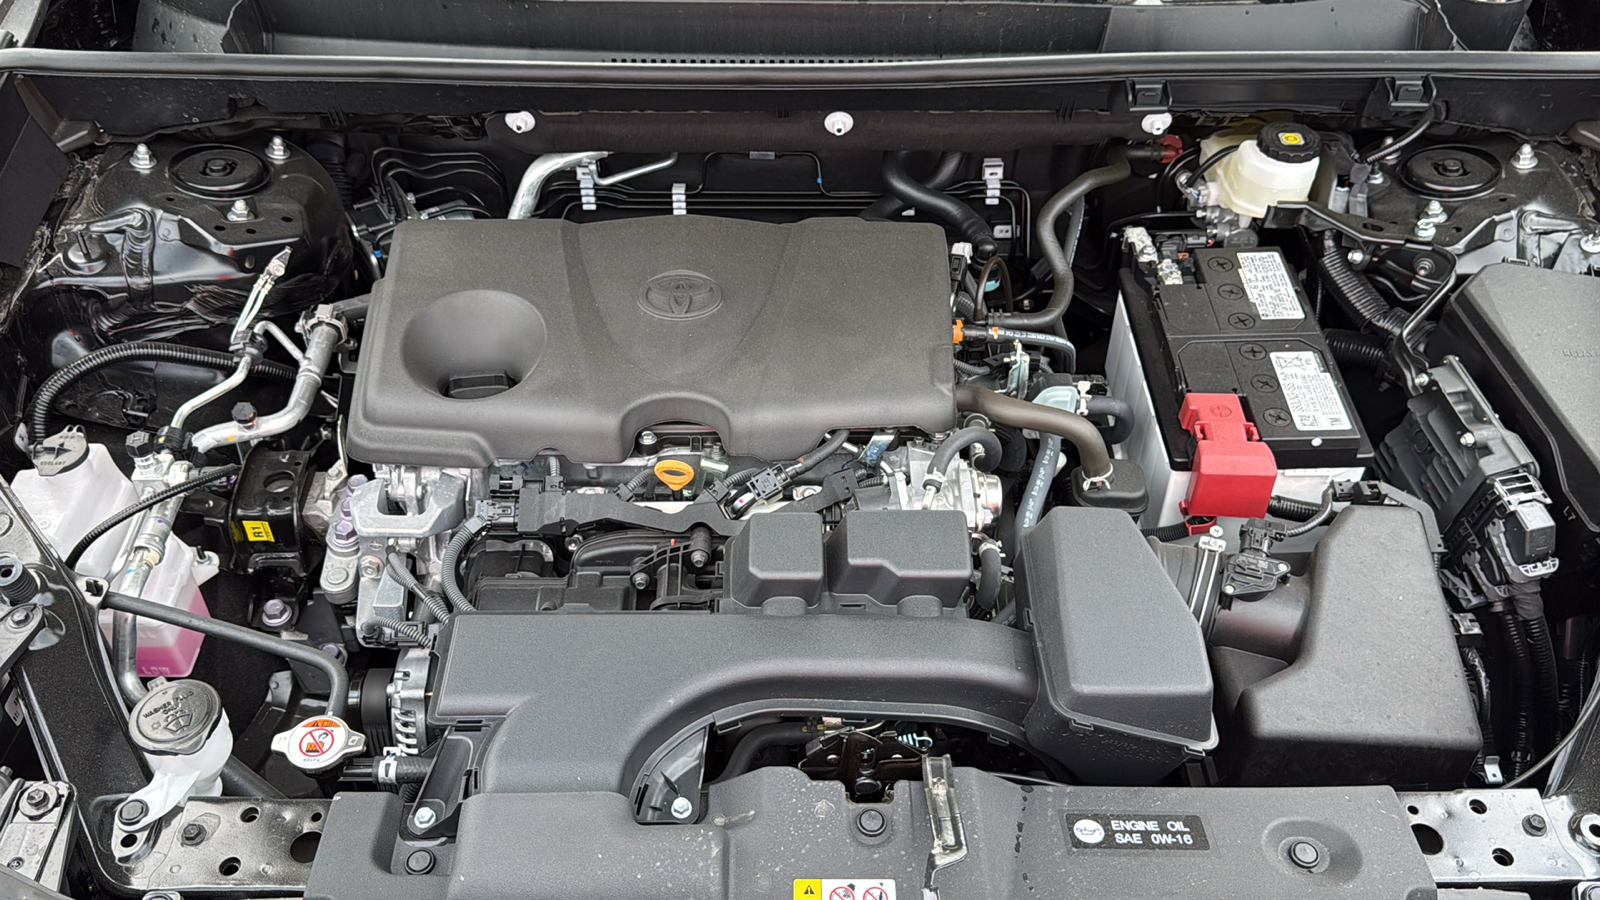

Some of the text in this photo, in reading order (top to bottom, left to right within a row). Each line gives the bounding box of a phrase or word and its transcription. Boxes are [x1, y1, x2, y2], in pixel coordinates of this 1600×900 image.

[1562, 349, 1594, 358] RELAY
[1562, 505, 1577, 521] L7
[251, 526, 265, 538] R1
[141, 666, 171, 675] LOW
[142, 701, 172, 719] WASHER
[1110, 820, 1190, 831] ENGINE OIL
[1114, 833, 1193, 845] SAE 0W-16
